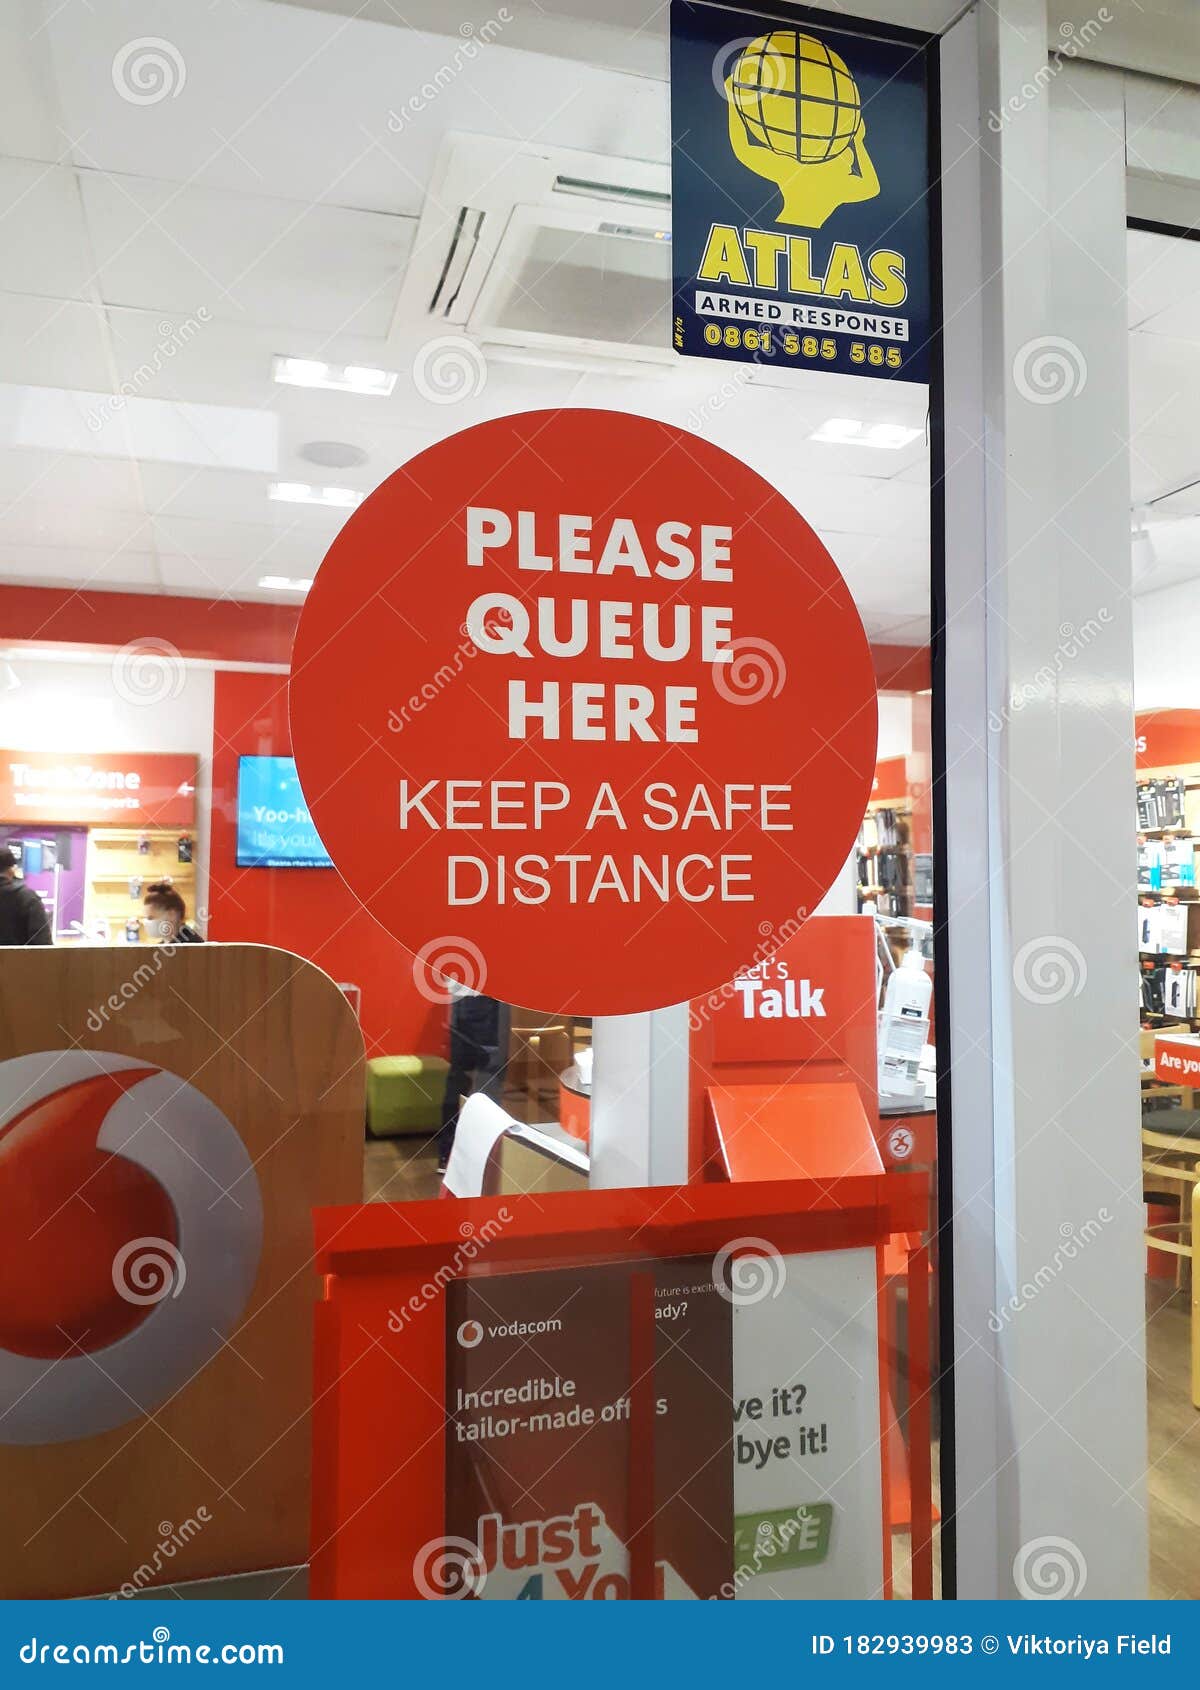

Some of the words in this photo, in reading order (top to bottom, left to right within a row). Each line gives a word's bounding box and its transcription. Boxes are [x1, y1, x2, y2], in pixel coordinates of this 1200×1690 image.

[697, 223, 908, 307] ATLAS
[701, 296, 782, 320] ARMED
[792, 307, 904, 337] RESPONSE
[703, 323, 772, 352] 0861
[783, 333, 838, 360] 585
[849, 342, 903, 368] 585
[466, 506, 734, 582] PLEASE
[465, 592, 734, 664] QUEUE
[508, 679, 699, 743] HERE
[253, 805, 311, 823] Yoo-h
[399, 780, 571, 831] KEEP
[585, 782, 627, 831] A
[643, 782, 794, 832] SAFE
[447, 853, 755, 906] DISTANCE
[734, 979, 827, 1019] Talk
[1160, 1051, 1182, 1069] Are
[488, 1319, 562, 1338] vodacom
[655, 1302, 688, 1321] ady?
[457, 1376, 577, 1411] Incredible
[772, 1384, 807, 1417] it?
[456, 1404, 595, 1442] tailor-made
[735, 1435, 791, 1470] bye
[800, 1424, 828, 1457] it!
[471, 1506, 603, 1577] Just
